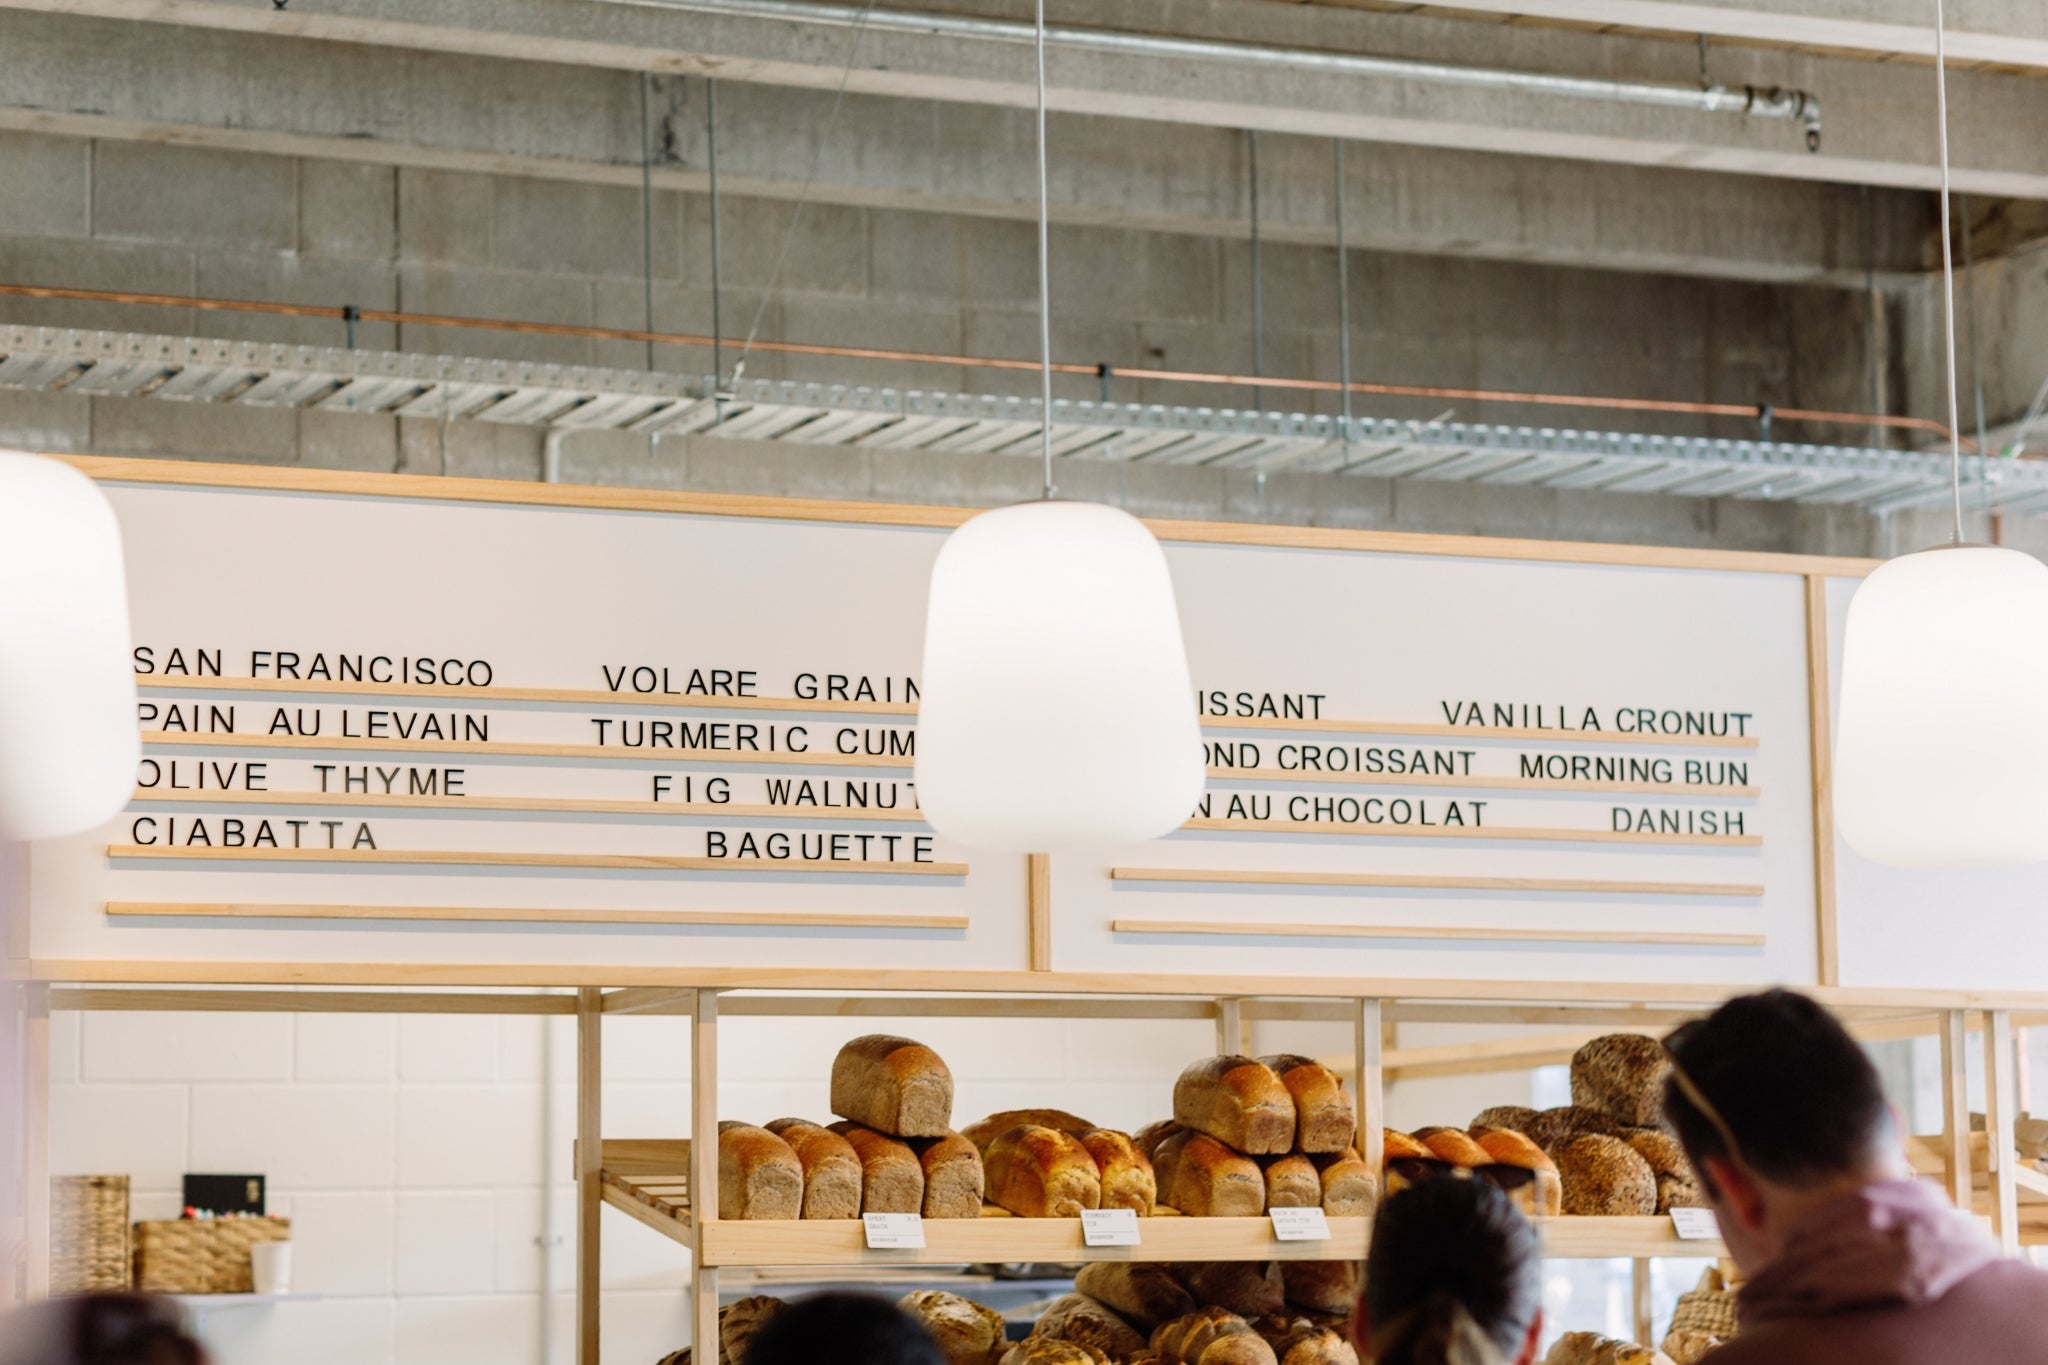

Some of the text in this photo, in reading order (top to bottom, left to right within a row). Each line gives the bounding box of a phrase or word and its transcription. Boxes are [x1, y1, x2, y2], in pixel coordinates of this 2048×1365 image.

[133, 646, 493, 687] SAN FRANCISCO
[602, 665, 758, 697] VOLARE
[1199, 690, 1326, 720] ISSANT
[1442, 701, 1753, 737] VANILLA CRONUT
[137, 703, 488, 742] PAIN AU LEVAIN
[591, 718, 915, 756] TURMERIC CUM
[1278, 744, 1476, 776] CROISSANT
[1520, 754, 1748, 785] MORNING BUN
[137, 759, 466, 796] OLIVE THYME
[653, 775, 731, 804] FIG
[1227, 794, 1271, 819] AU
[1289, 796, 1487, 827] CHOCOLAT
[1612, 807, 1744, 835] DANISH
[132, 817, 377, 850] CIABATTA
[706, 831, 934, 863] BAGUETTE
